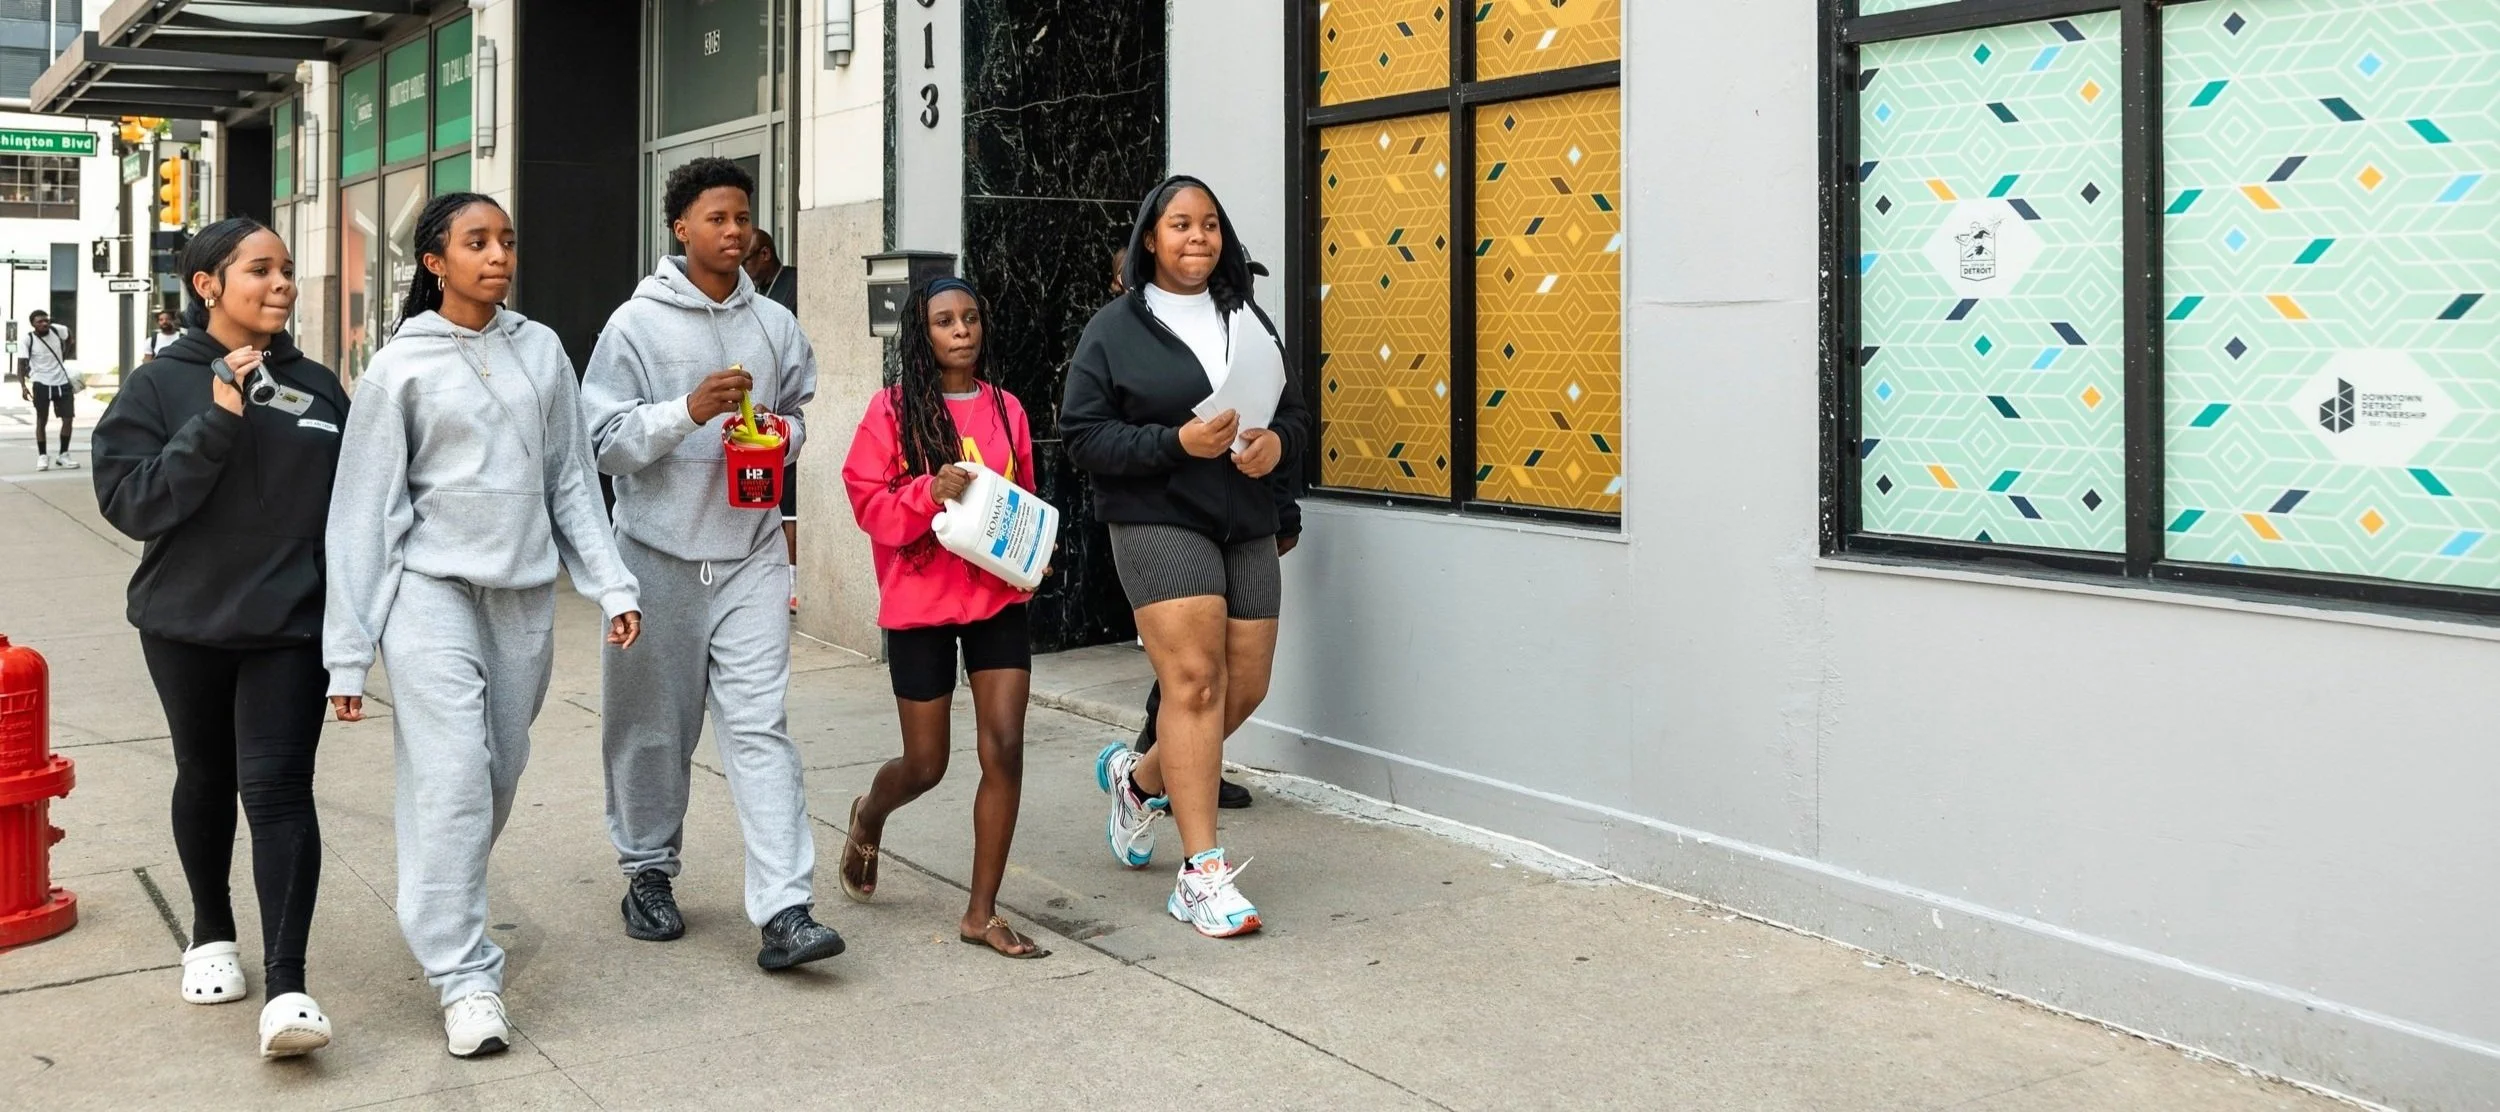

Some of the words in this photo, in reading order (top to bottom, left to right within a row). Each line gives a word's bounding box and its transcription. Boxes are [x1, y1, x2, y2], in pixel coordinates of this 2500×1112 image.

[917, 0, 940, 129] 13
[61, 136, 92, 149] Blvd
[2362, 393, 2422, 402] DOWNTOWN
[2362, 402, 2402, 410] DETROIT
[2362, 410, 2427, 419] PARTNERSHIP
[986, 494, 1004, 538] ROMAN
